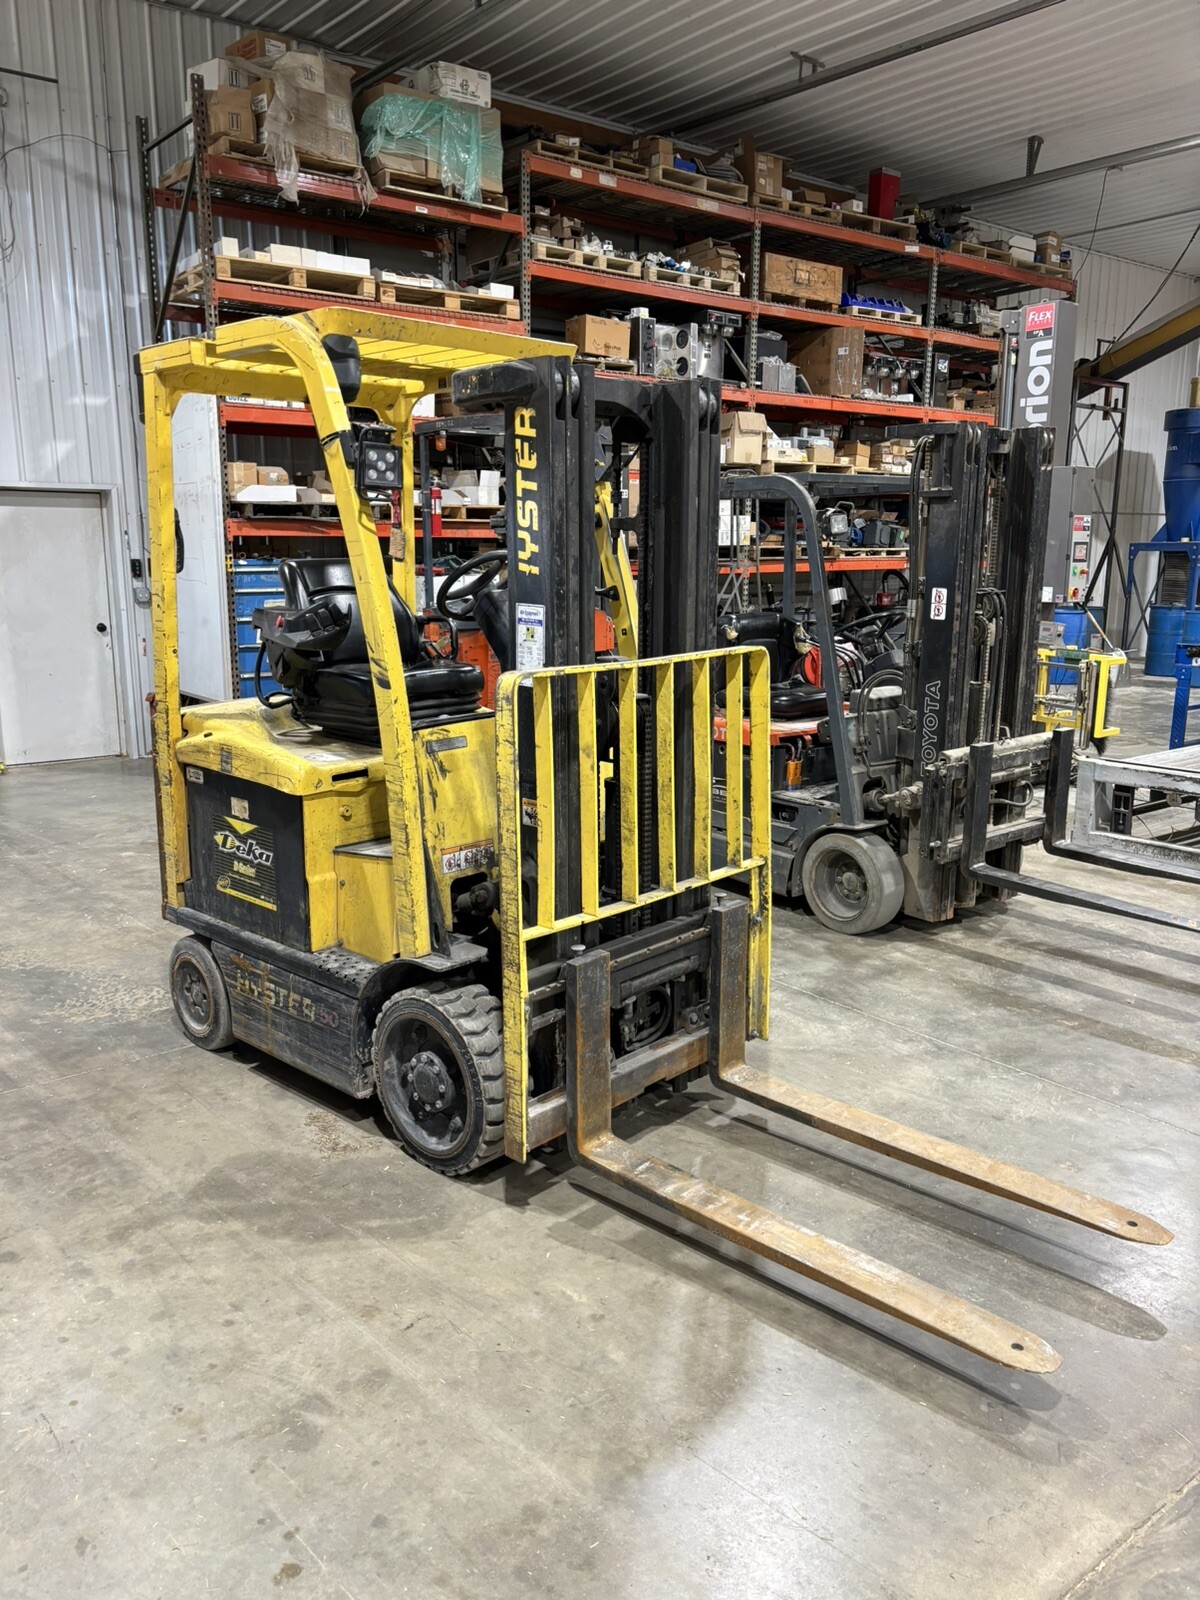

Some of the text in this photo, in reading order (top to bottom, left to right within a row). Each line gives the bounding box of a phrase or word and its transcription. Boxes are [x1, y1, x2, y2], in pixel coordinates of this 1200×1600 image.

[1028, 310, 1053, 323] FLEX
[1020, 339, 1053, 427] rion
[921, 680, 941, 777] TOYOTA
[214, 830, 274, 866] Deka
